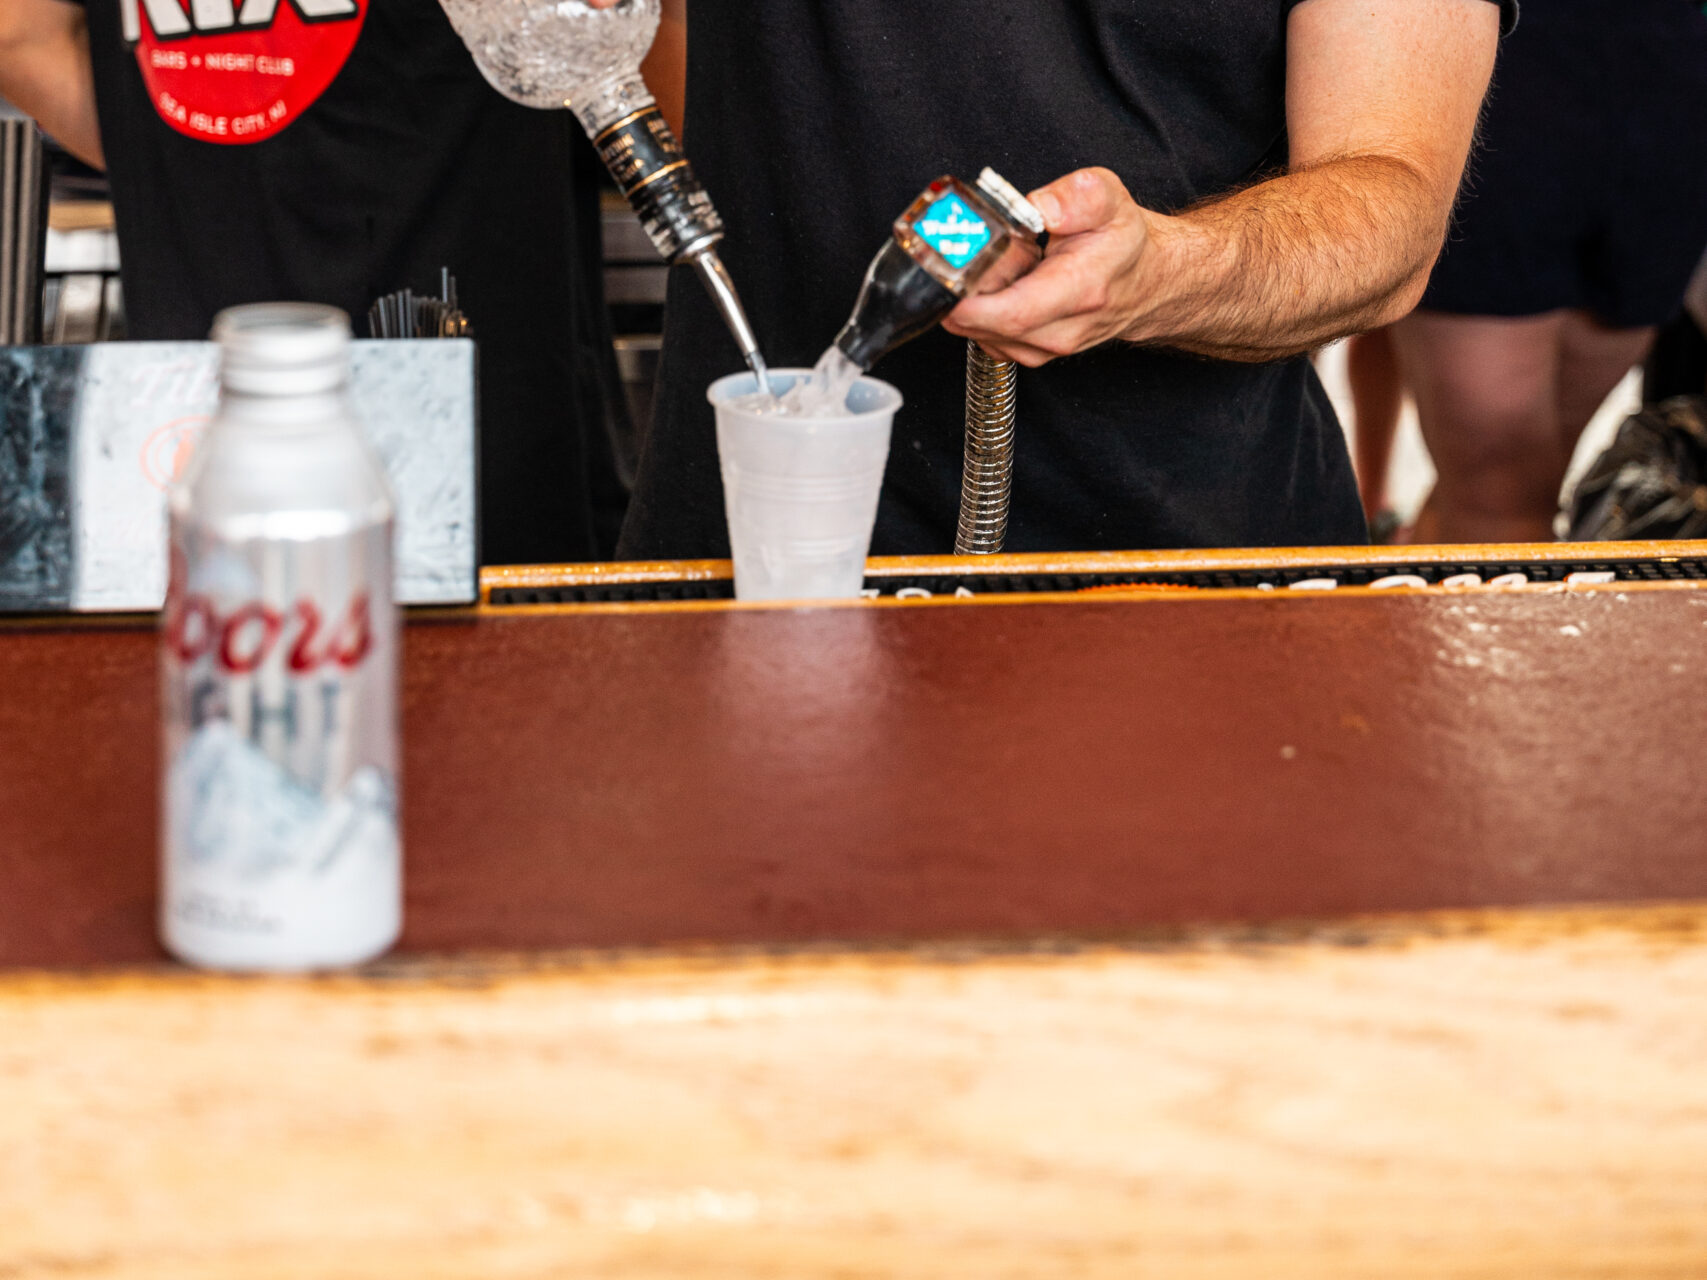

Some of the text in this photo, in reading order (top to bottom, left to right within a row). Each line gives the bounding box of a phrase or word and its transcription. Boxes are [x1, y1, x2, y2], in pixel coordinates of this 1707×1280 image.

[204, 53, 255, 72] NIGHT
[256, 56, 295, 76] CLUB
[189, 111, 228, 135] ISLE
